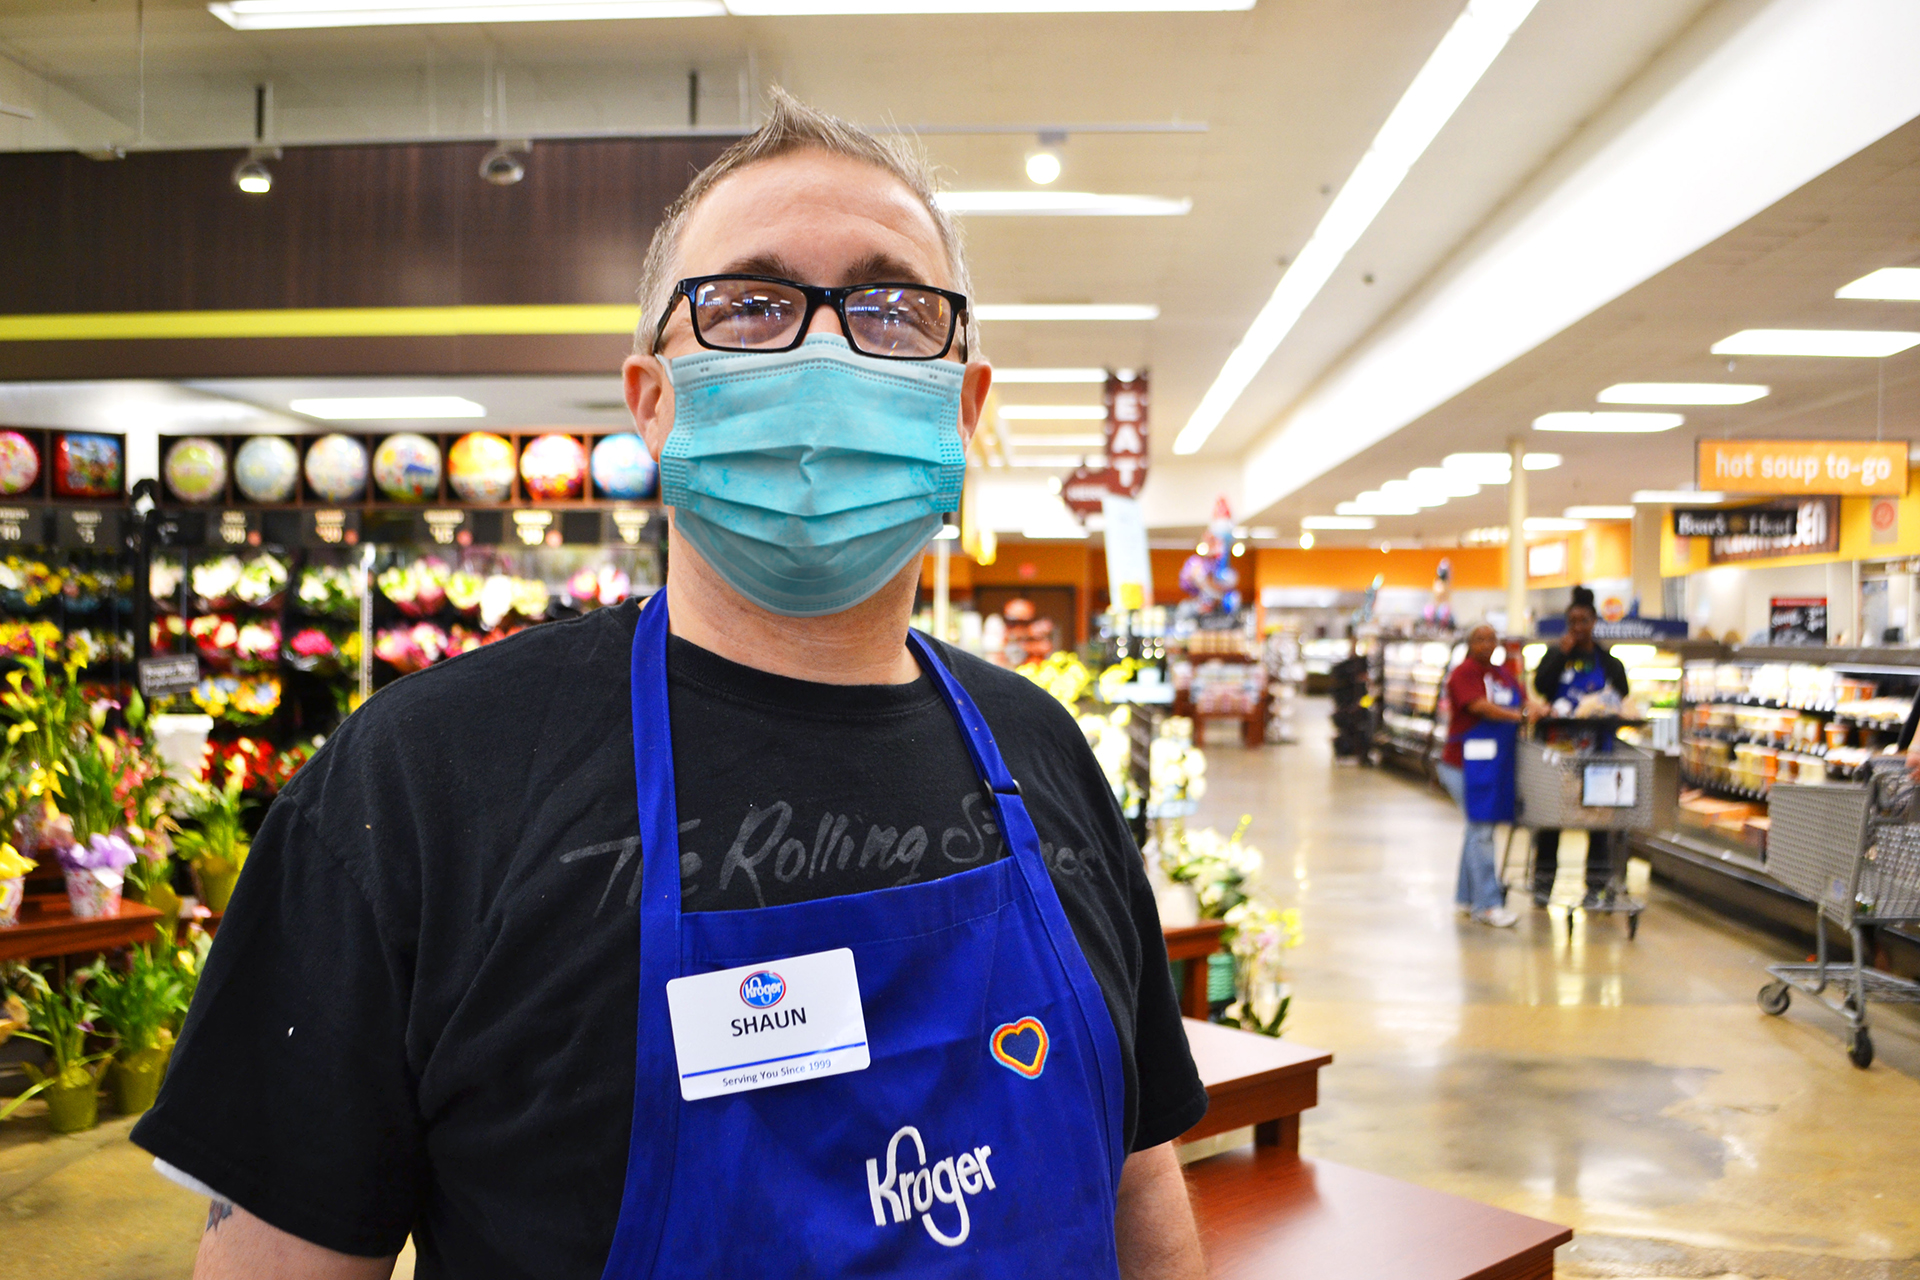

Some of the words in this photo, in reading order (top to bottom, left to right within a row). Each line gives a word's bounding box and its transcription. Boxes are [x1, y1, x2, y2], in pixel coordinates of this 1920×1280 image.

[1111, 391, 1142, 488] EAT
[1715, 449, 1755, 479] hot
[1761, 454, 1820, 486] soup
[1824, 452, 1892, 487] to-go
[718, 800, 929, 908] Rolling
[744, 976, 783, 1005] Kroger
[730, 1007, 808, 1037] SHAUN
[722, 1071, 758, 1088] Serving
[760, 1070, 779, 1081] You
[781, 1065, 806, 1076] Since
[809, 1059, 832, 1071] 1999
[866, 1125, 997, 1246] Kroger
